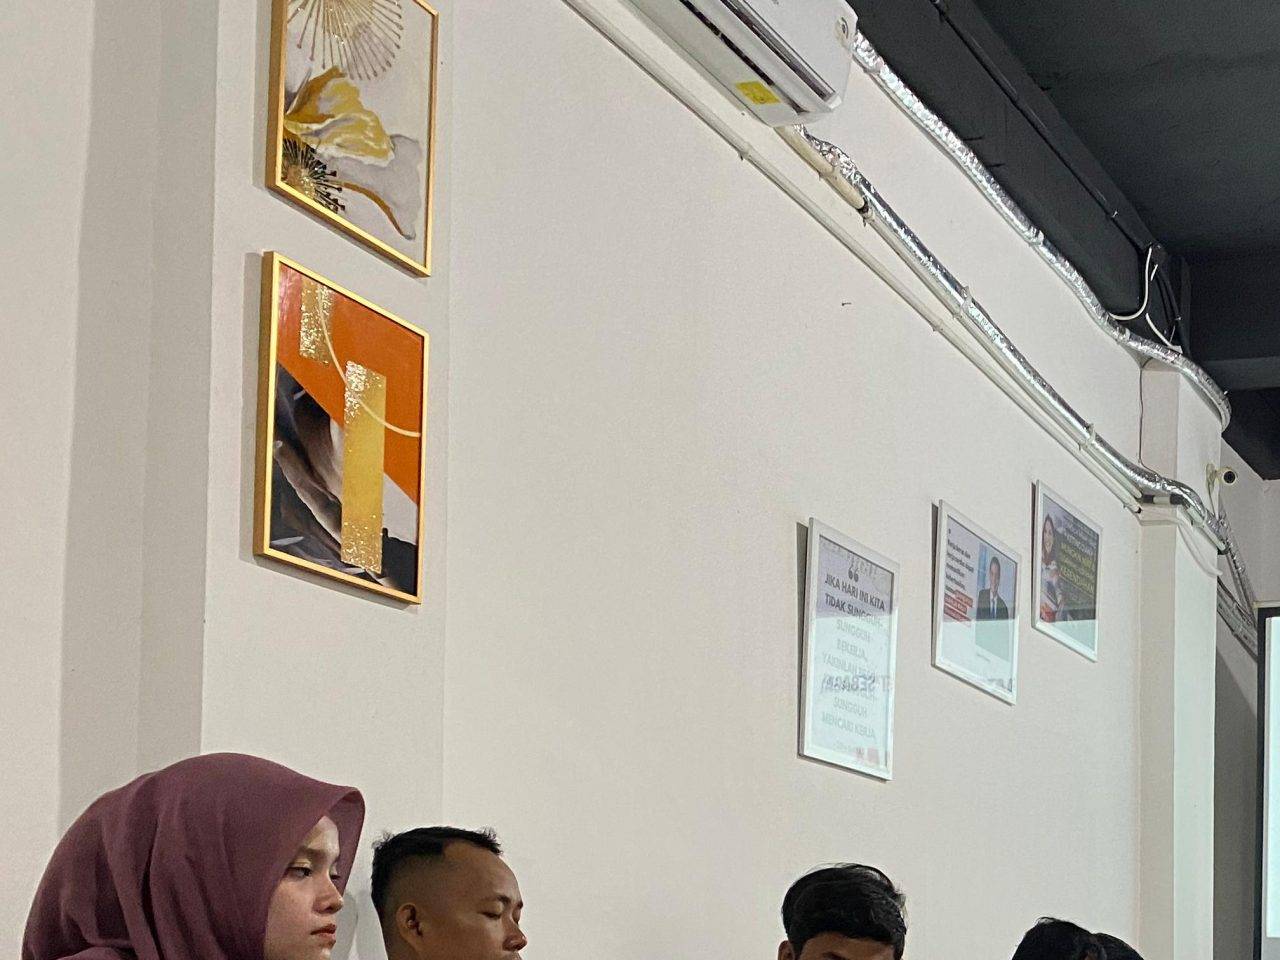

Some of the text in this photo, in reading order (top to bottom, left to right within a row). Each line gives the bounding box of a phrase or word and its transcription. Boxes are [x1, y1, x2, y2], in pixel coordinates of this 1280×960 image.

[825, 593, 846, 612] TIDAK
[842, 581, 858, 599] HARI
[870, 595, 885, 611] KITA
